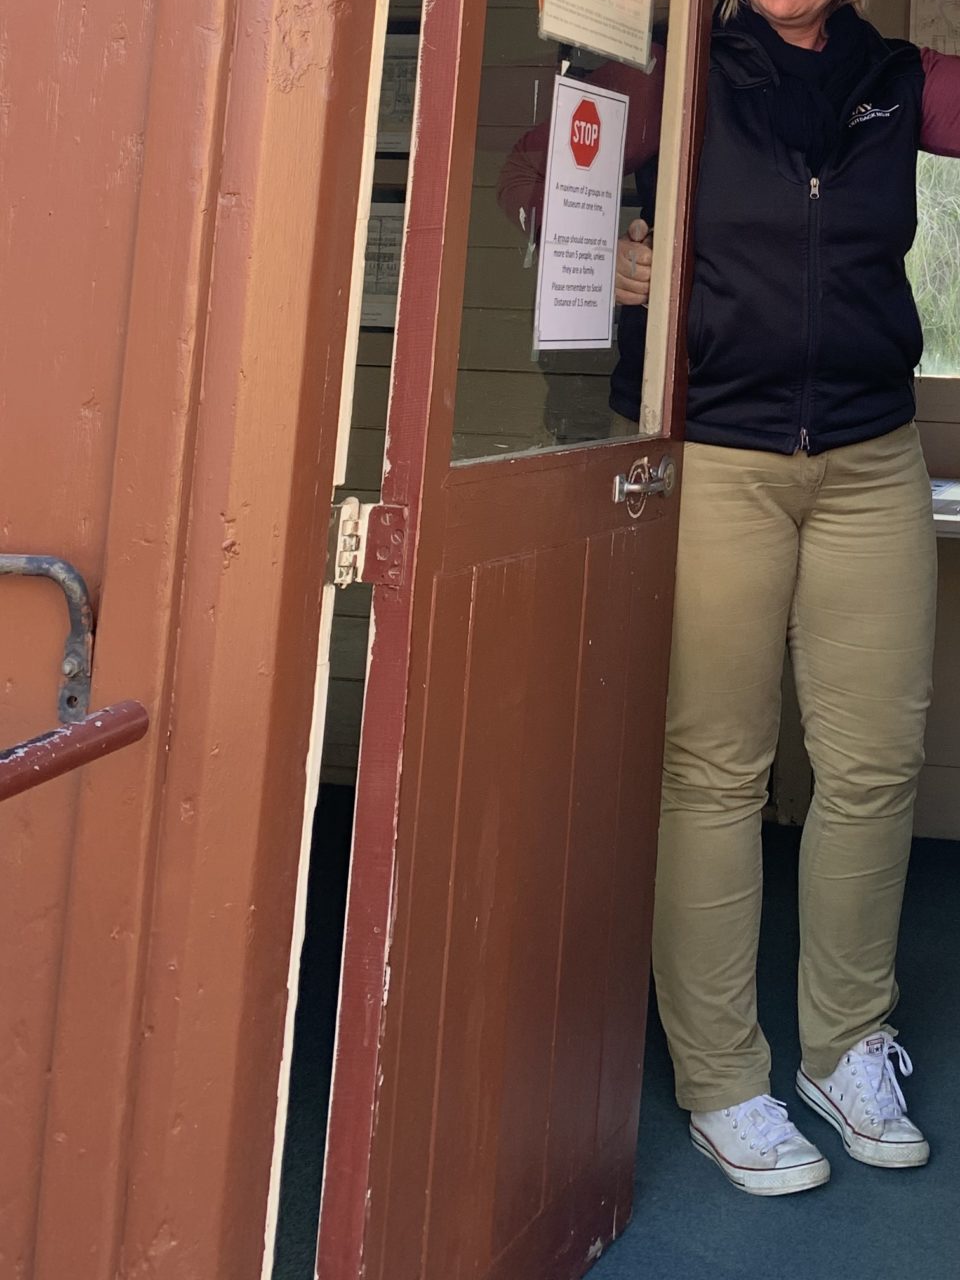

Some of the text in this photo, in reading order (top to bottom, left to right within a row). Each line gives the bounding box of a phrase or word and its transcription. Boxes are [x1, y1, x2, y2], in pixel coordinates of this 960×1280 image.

[573, 120, 598, 147] STOP
[563, 198, 580, 208] Museum
[558, 235, 569, 244] group
[552, 282, 565, 290] Please
[566, 283, 586, 291] remember
